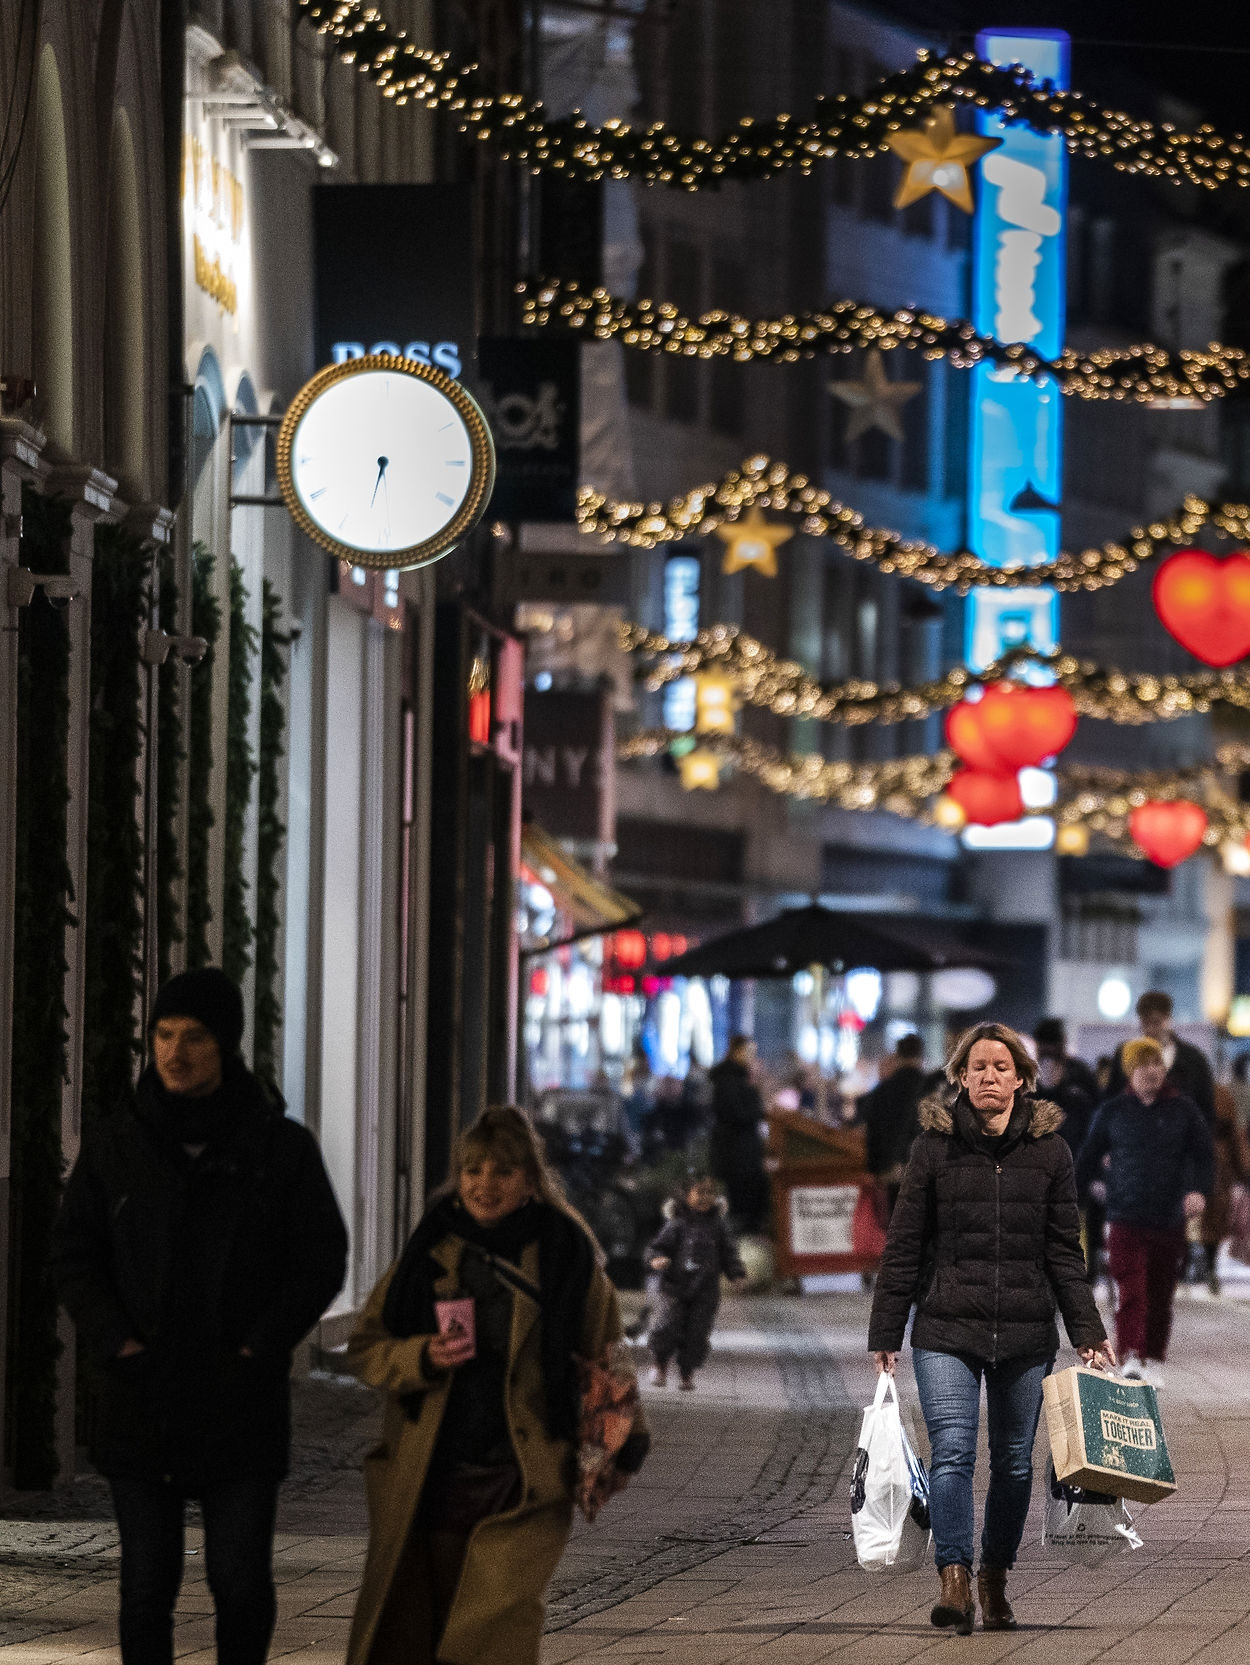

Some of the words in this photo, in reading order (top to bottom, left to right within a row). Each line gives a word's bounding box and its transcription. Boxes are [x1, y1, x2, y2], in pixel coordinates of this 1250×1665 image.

[1102, 1412, 1121, 1422] MAKE
[1129, 1420, 1150, 1428] REAL
[1103, 1419, 1153, 1447] TOGETHER
